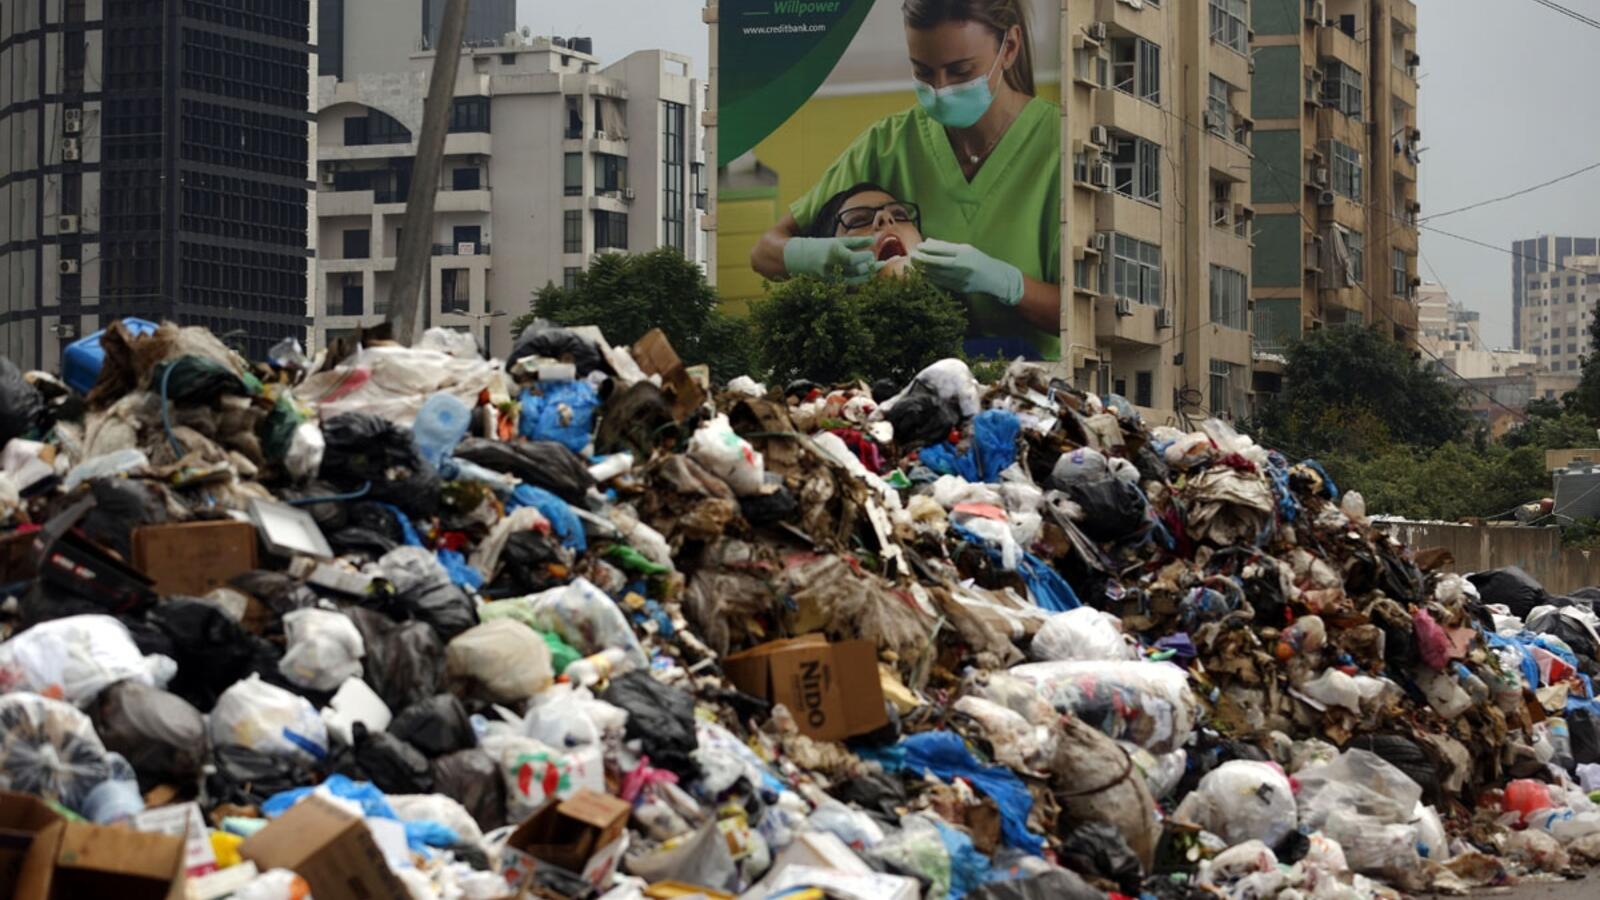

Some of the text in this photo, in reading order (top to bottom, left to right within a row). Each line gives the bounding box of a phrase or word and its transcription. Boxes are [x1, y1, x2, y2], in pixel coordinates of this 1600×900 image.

[773, 0, 840, 17] Willpower
[742, 23, 826, 35] www.creditbank.com
[799, 660, 826, 729] NIDO
